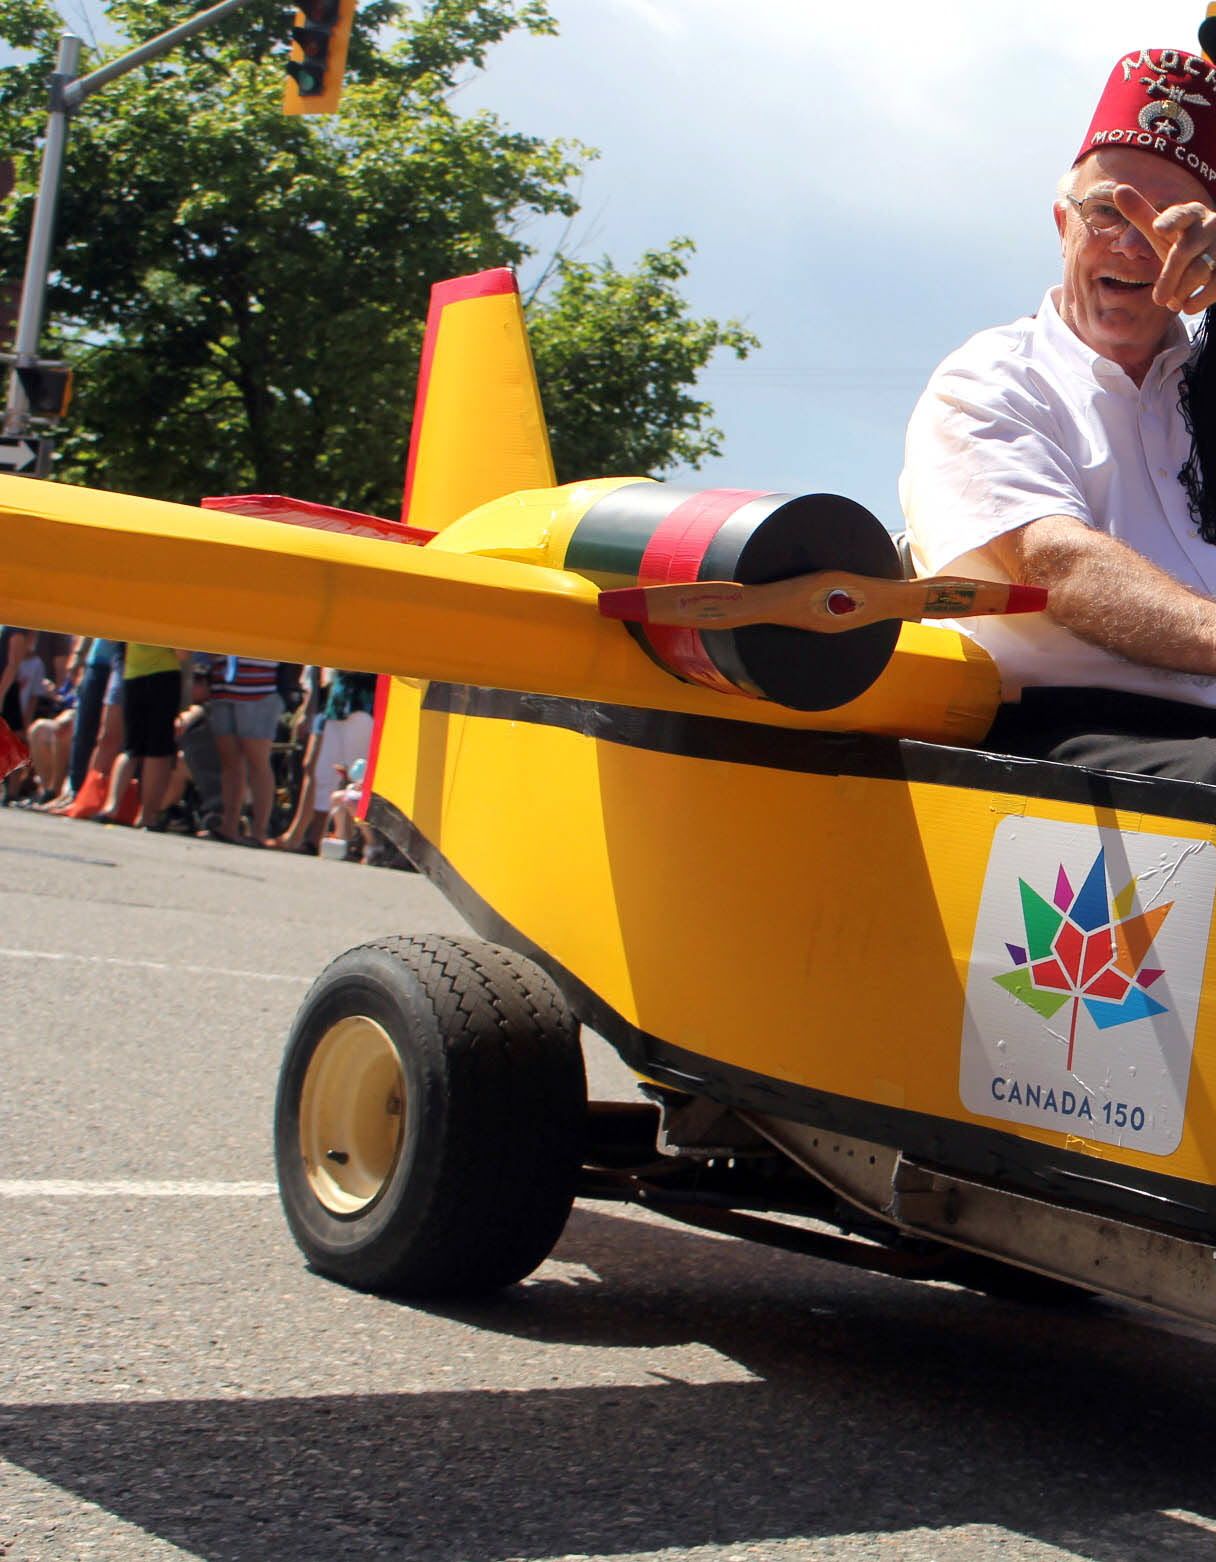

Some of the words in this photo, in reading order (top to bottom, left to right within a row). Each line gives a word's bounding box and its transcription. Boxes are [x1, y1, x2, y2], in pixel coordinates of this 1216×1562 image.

[1091, 129, 1167, 151] MOTOR
[1175, 147, 1216, 181] CORP
[991, 1077, 1093, 1120] CANADA
[1102, 1101, 1145, 1131] 150
